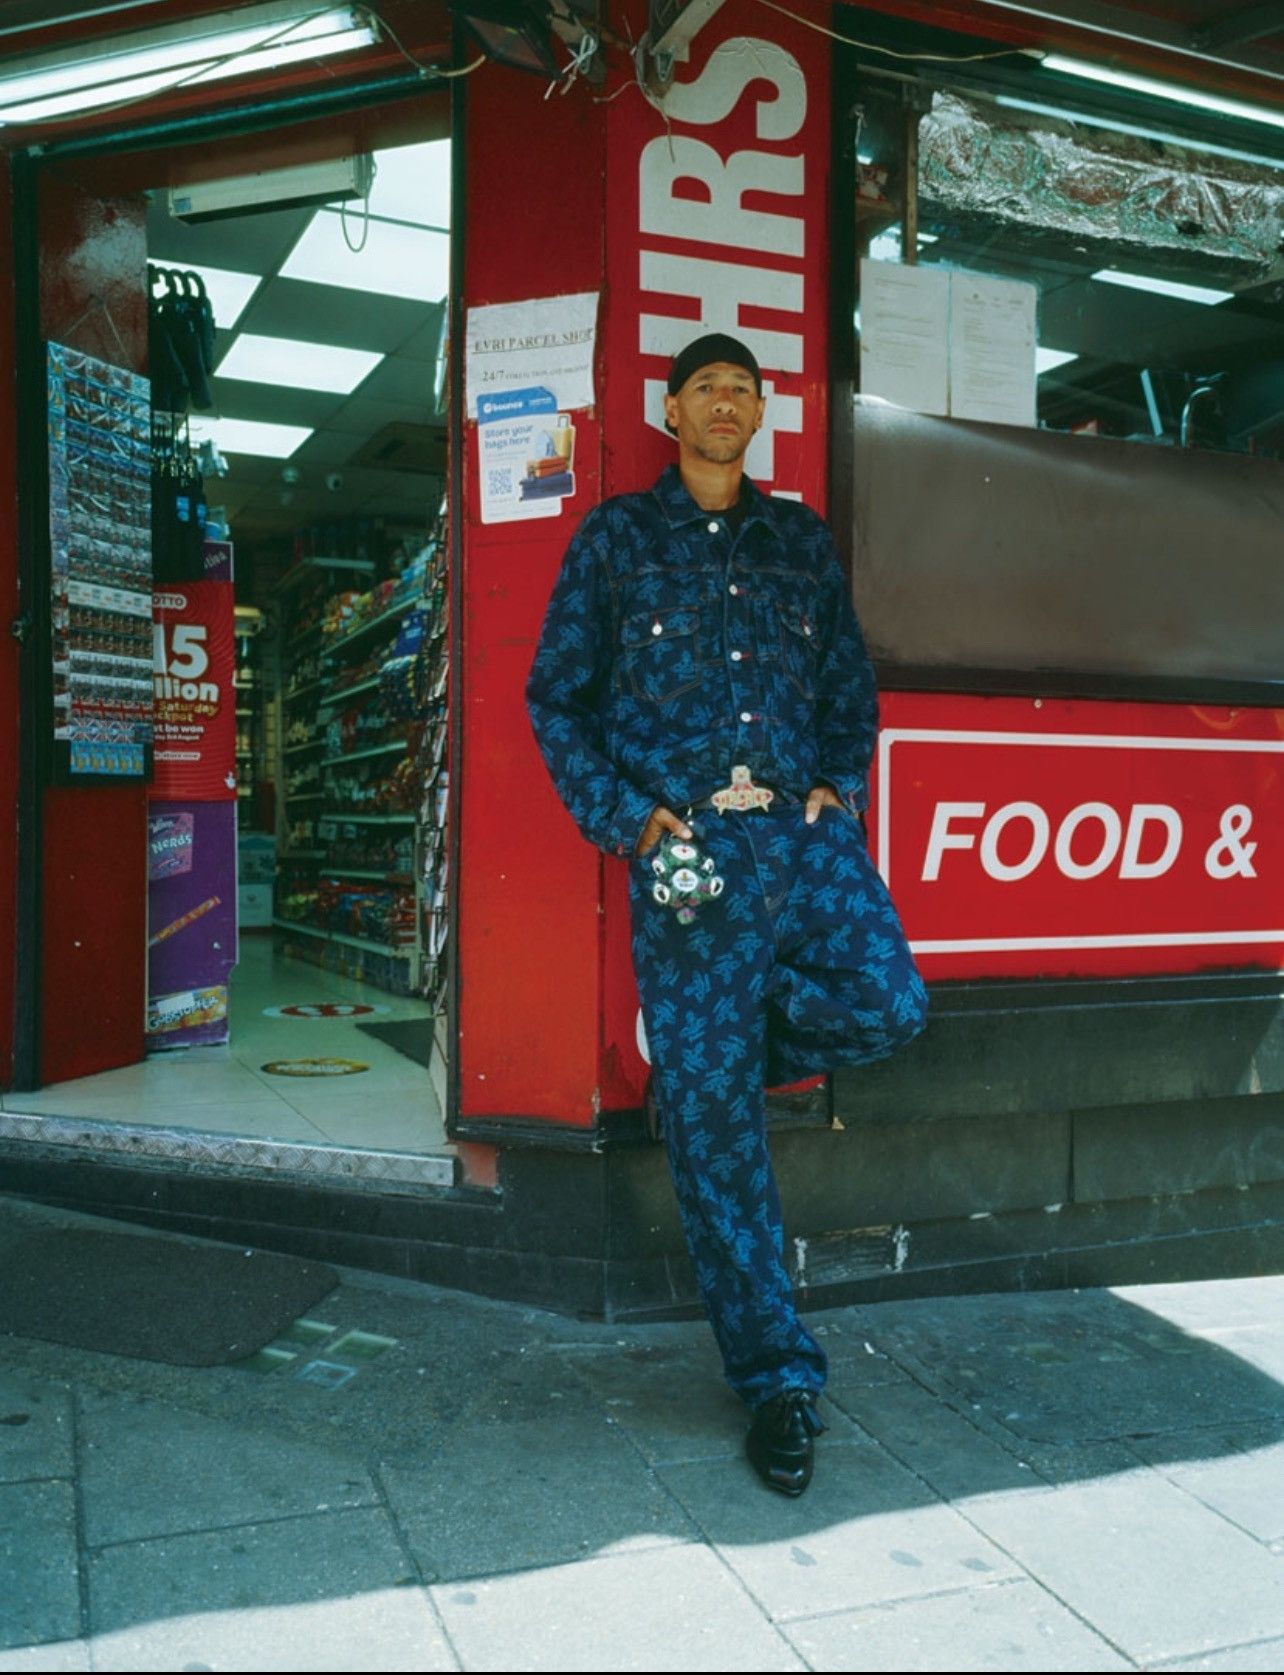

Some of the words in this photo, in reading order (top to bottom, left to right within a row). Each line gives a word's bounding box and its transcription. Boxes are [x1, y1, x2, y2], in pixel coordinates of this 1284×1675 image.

[639, 37, 807, 503] 4HRS
[508, 334, 557, 349] PARCEL
[493, 401, 523, 412] bounce
[485, 428, 510, 438] Store
[511, 425, 533, 437] your
[484, 440, 507, 450] bags
[508, 437, 530, 446] here
[152, 594, 184, 607] OTTO
[154, 677, 219, 702] llion
[154, 711, 194, 723] ckpot
[921, 801, 1183, 882] FOOD
[1204, 804, 1258, 880] &
